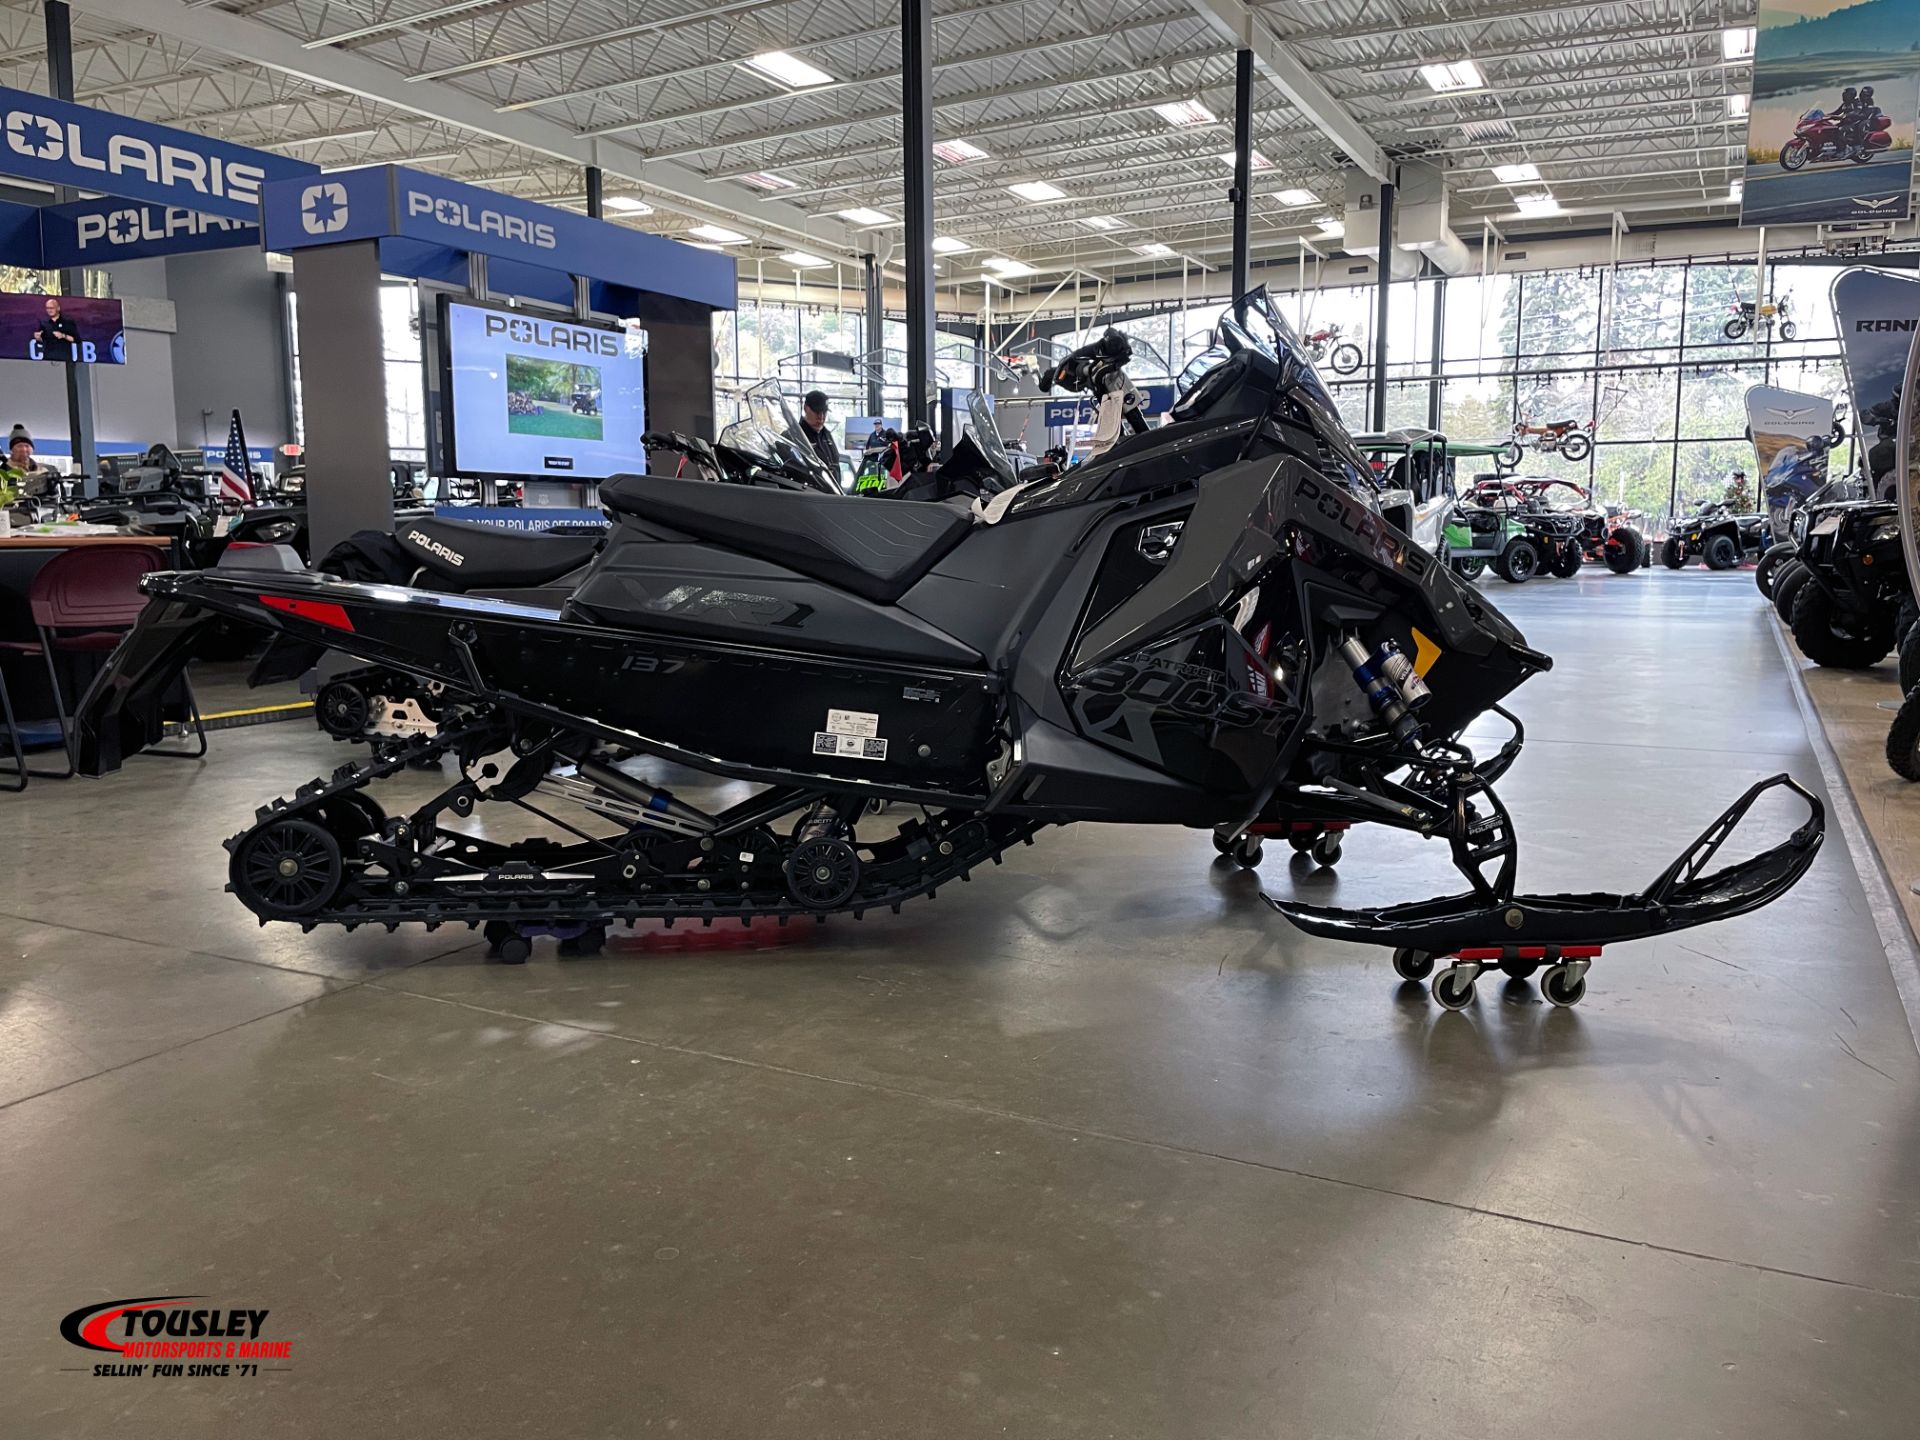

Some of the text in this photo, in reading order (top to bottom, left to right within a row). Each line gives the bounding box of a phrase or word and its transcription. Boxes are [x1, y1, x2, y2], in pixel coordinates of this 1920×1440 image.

[0, 111, 265, 204] OLARIS
[77, 207, 259, 249] POLAR
[408, 190, 556, 249] POLARIS
[485, 315, 618, 357] POLARIS
[1294, 476, 1426, 576] POLARIS
[407, 529, 465, 567] POLARIS
[621, 655, 687, 674] 137
[1468, 819, 1504, 836] POLARIS
